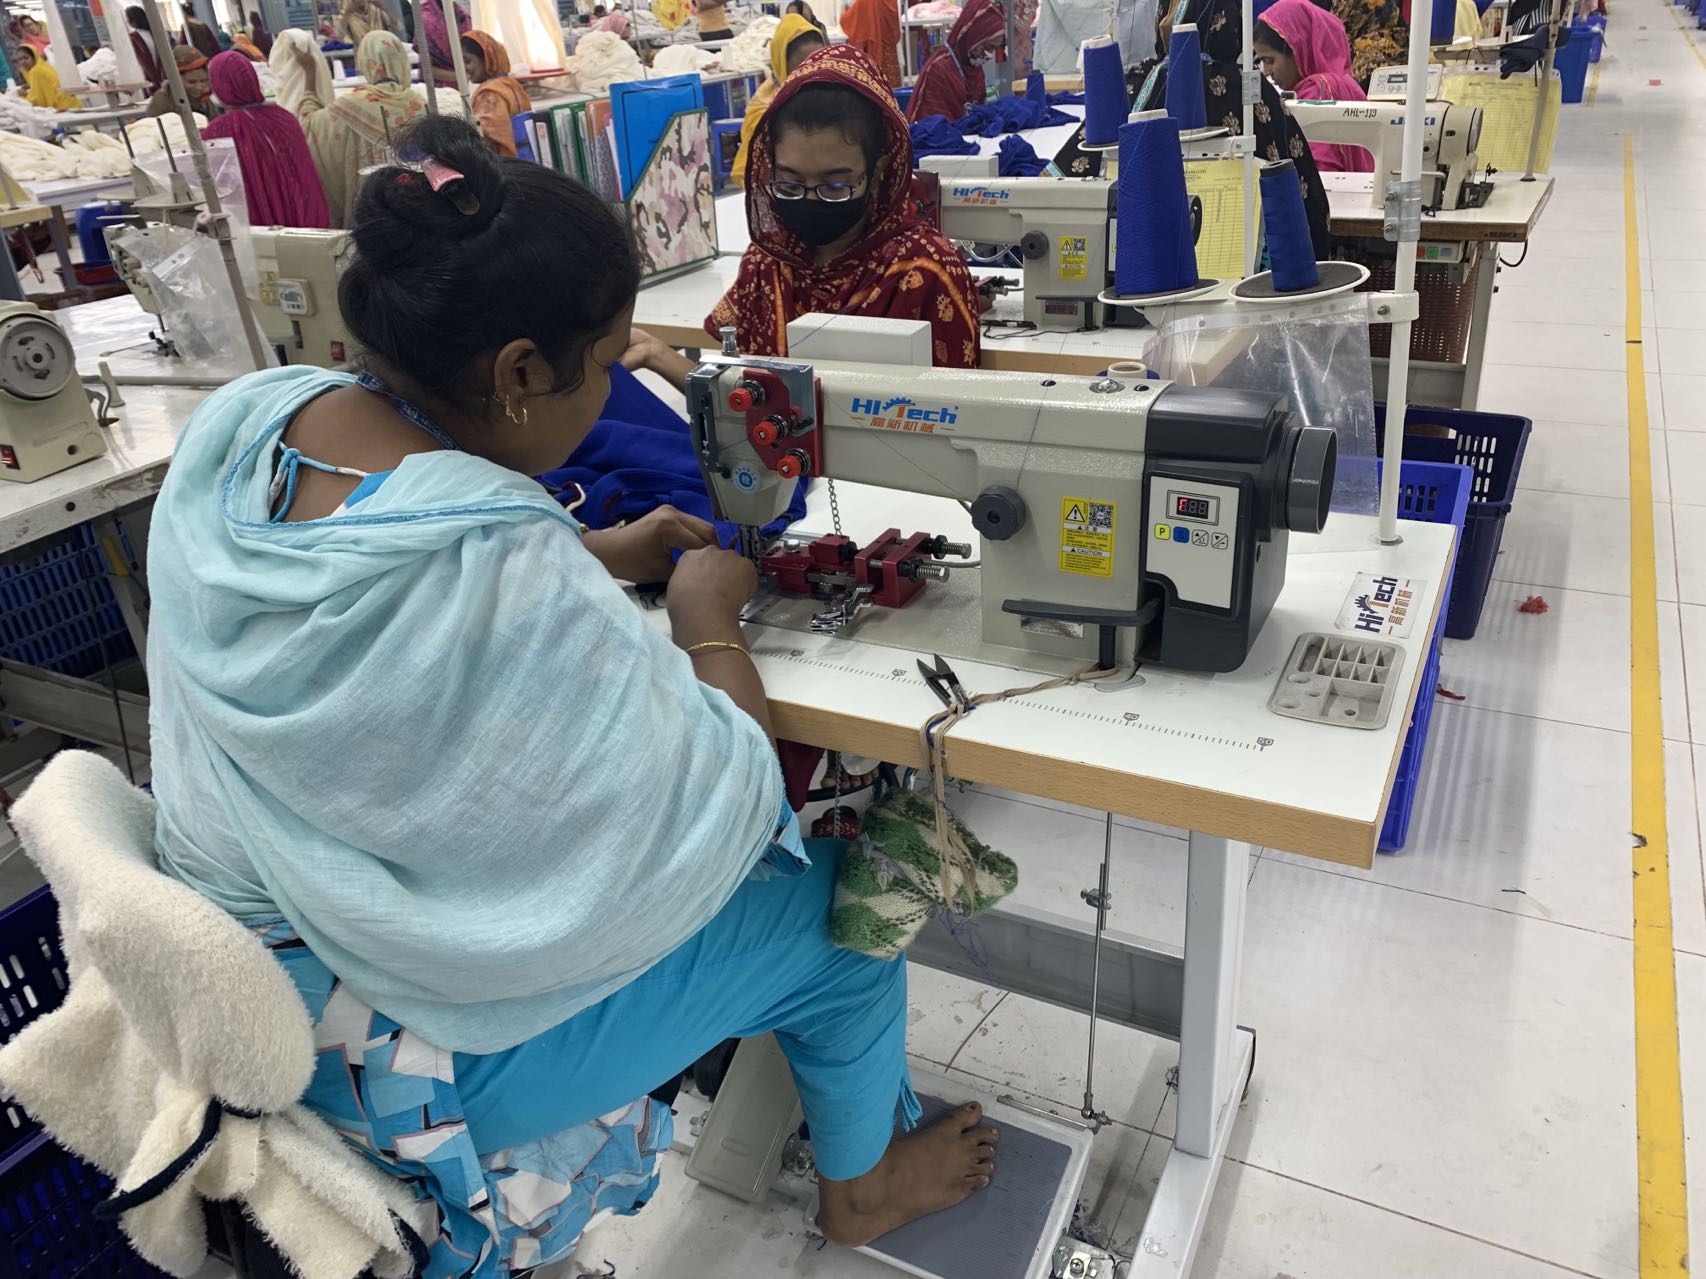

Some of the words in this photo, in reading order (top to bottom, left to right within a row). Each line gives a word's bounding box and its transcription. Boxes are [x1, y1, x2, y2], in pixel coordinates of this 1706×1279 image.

[1076, 548, 1103, 557] CAUTION
[1124, 712, 1139, 721] 40
[1257, 737, 1274, 746] 50
